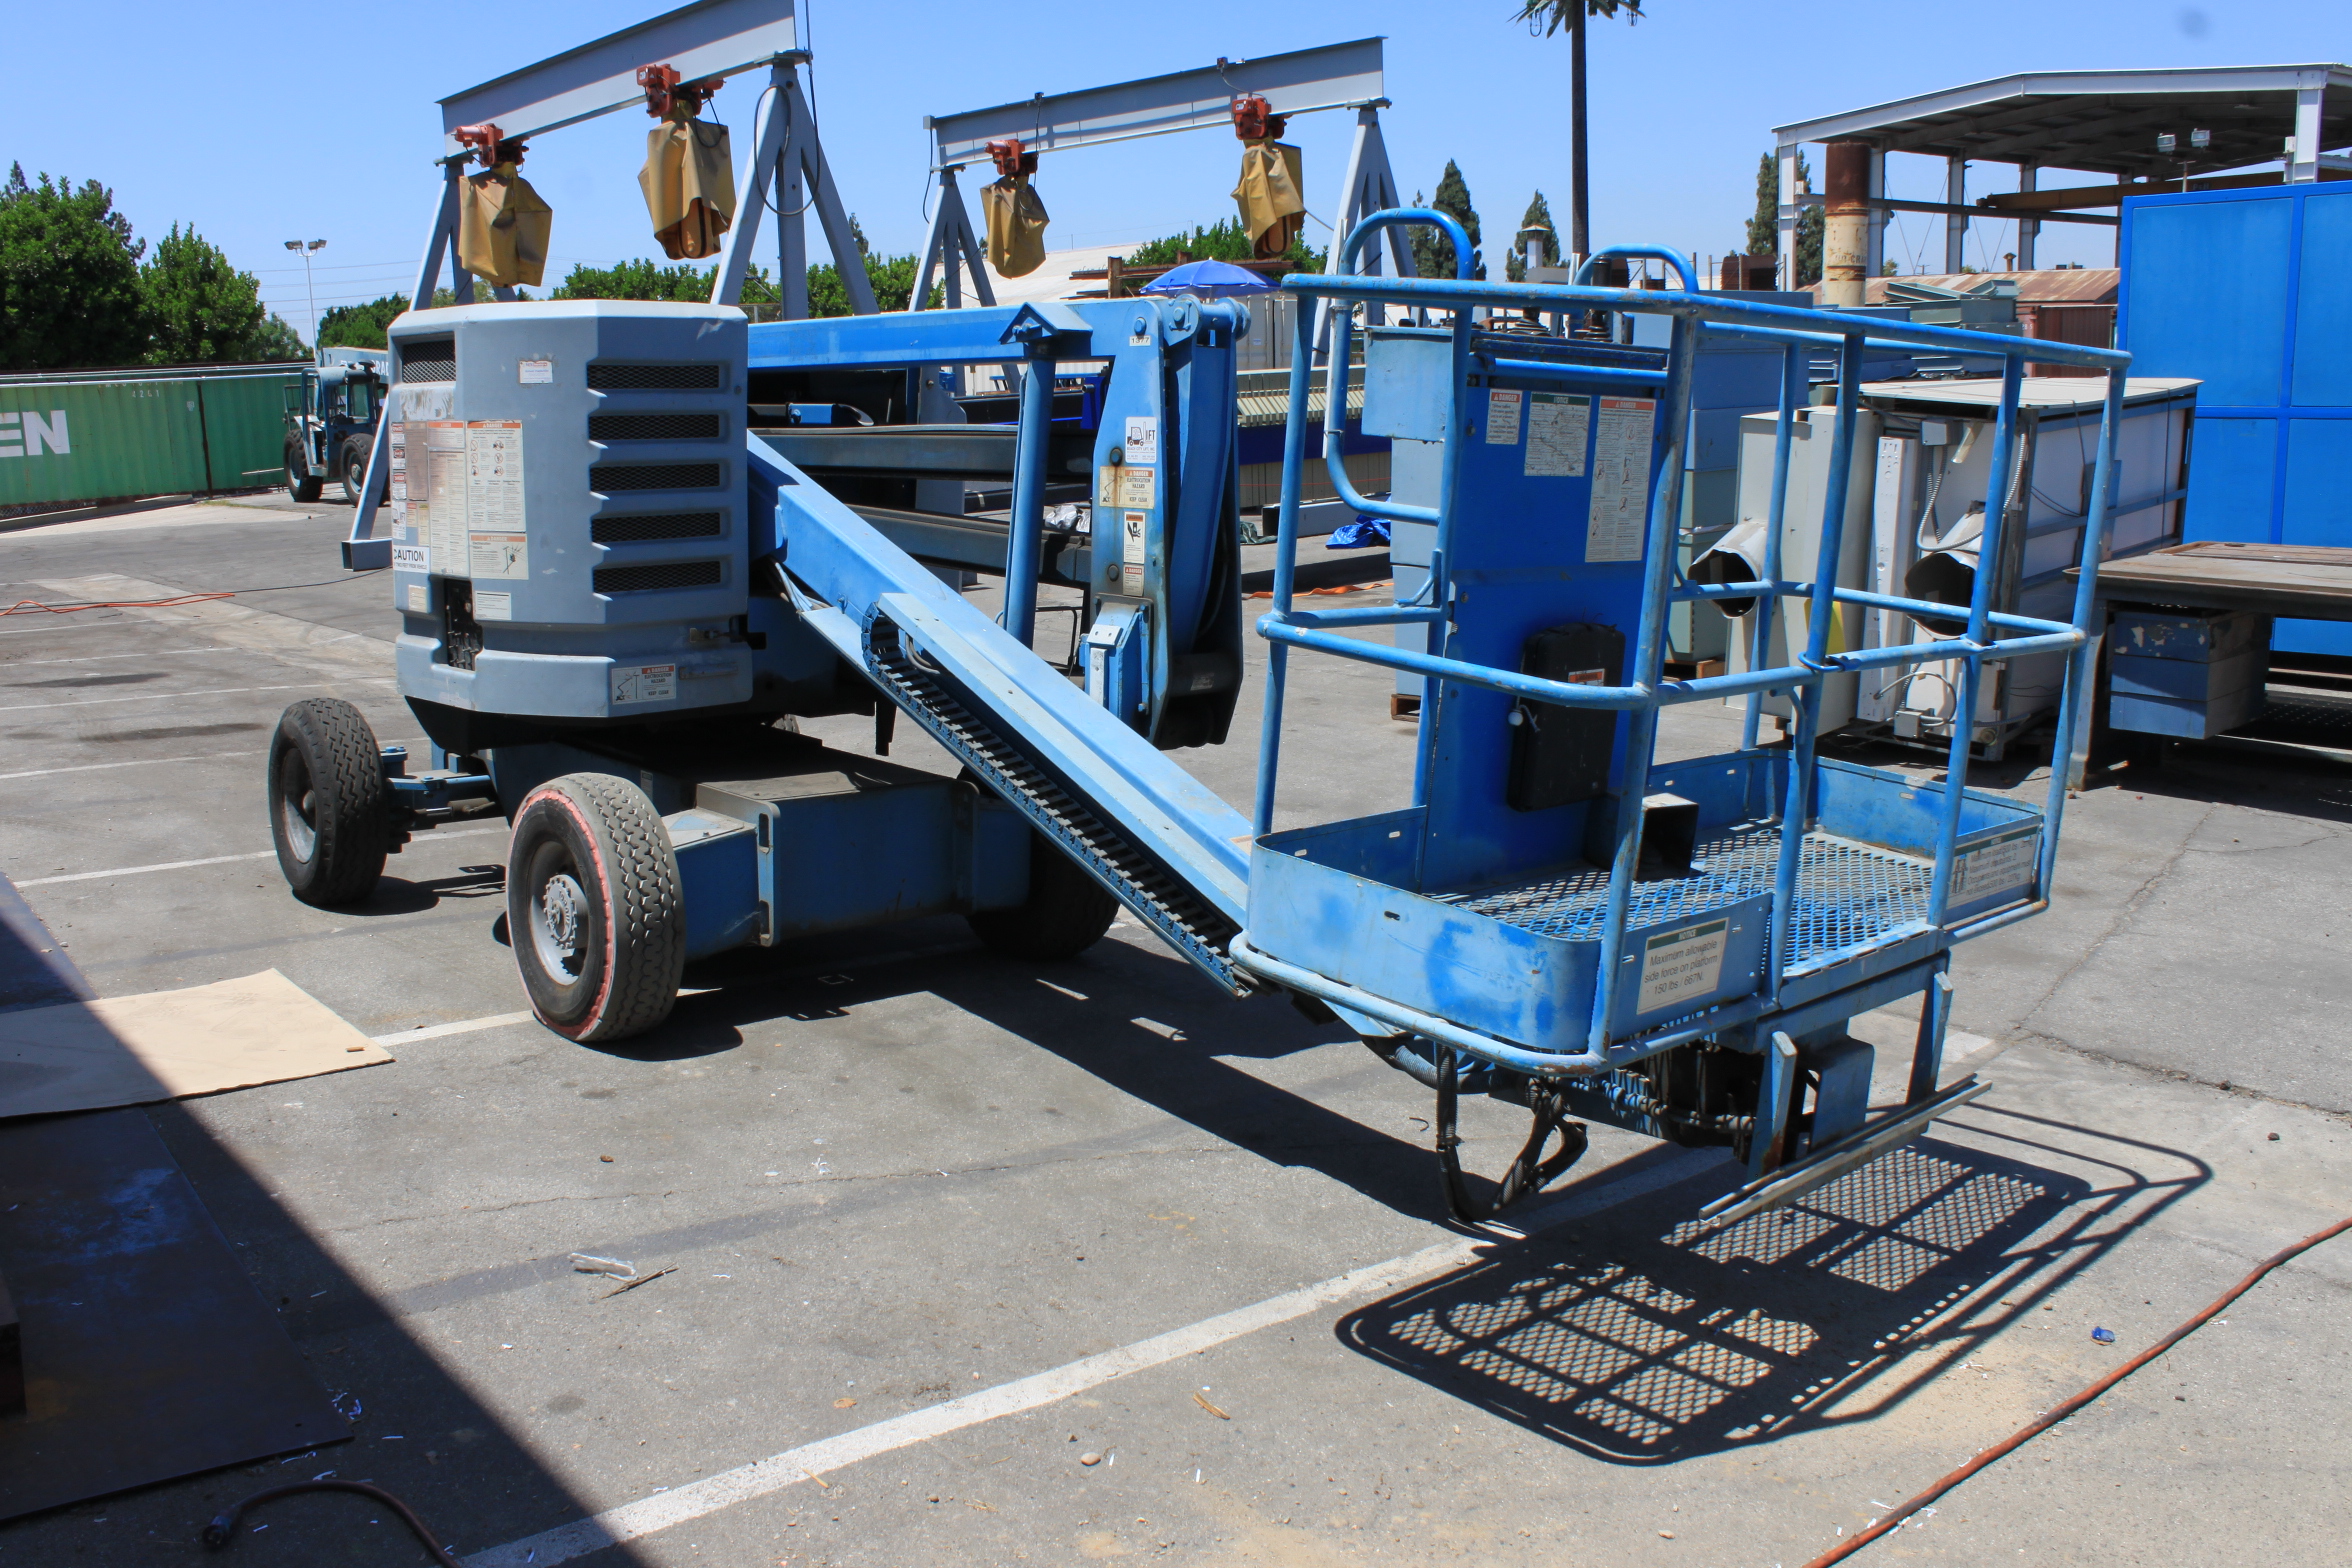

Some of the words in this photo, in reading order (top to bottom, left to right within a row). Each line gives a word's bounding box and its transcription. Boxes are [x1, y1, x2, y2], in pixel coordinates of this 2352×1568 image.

[1499, 393, 1517, 402] DANGER
[1620, 401, 1636, 409] DANGER
[394, 549, 424, 562] CAUTION
[1679, 928, 1697, 940] NOTICE
[1650, 949, 1684, 966] Maximum
[1685, 940, 1718, 956] allowable
[1644, 971, 1659, 983] side
[1660, 965, 1678, 978] force
[1679, 962, 1689, 973] on
[1690, 954, 1718, 970] platform
[1654, 982, 1667, 995] 150
[1667, 978, 1679, 990] lbs
